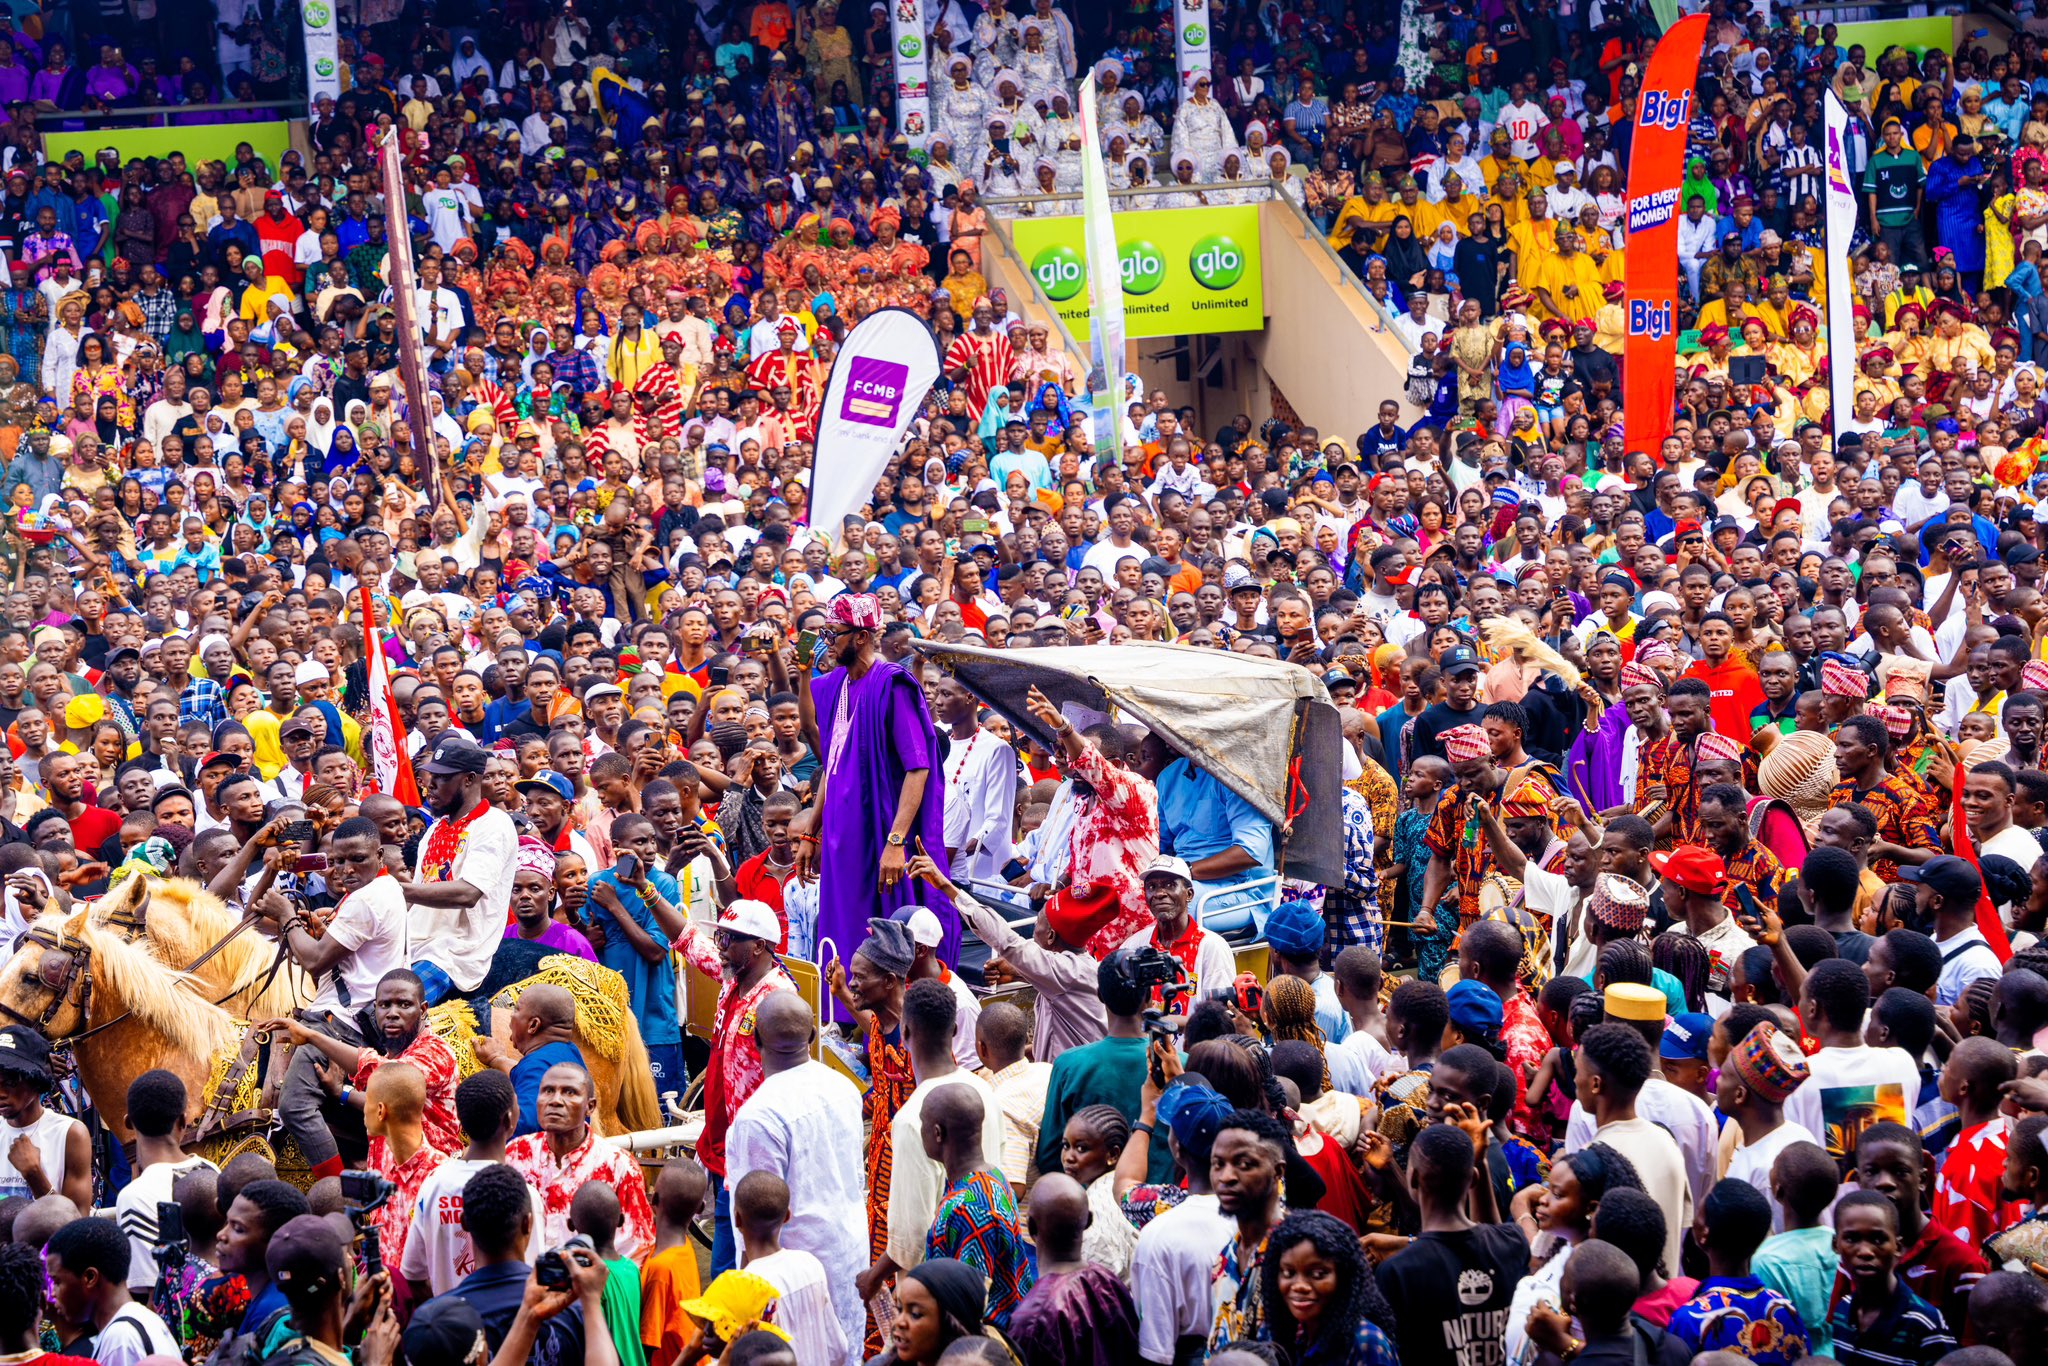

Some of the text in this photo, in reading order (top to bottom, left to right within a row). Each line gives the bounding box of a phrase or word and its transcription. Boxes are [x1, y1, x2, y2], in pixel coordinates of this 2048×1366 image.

[1186, 28, 1204, 42] glo
[901, 39, 919, 53] glo
[1640, 89, 1691, 130] Bigi
[1512, 121, 1529, 140] 10
[1630, 195, 1650, 213] FOR
[1651, 187, 1680, 207] EVERY
[1631, 204, 1674, 228] MOMENT
[1120, 251, 1159, 284] glo
[1197, 246, 1238, 278] glo
[1038, 256, 1080, 290] glo
[1058, 308, 1090, 320] mited
[1123, 303, 1170, 315] nlimited
[1192, 298, 1248, 310] Unlimited
[1629, 299, 1672, 340] Bigi
[853, 380, 896, 399] FCMB
